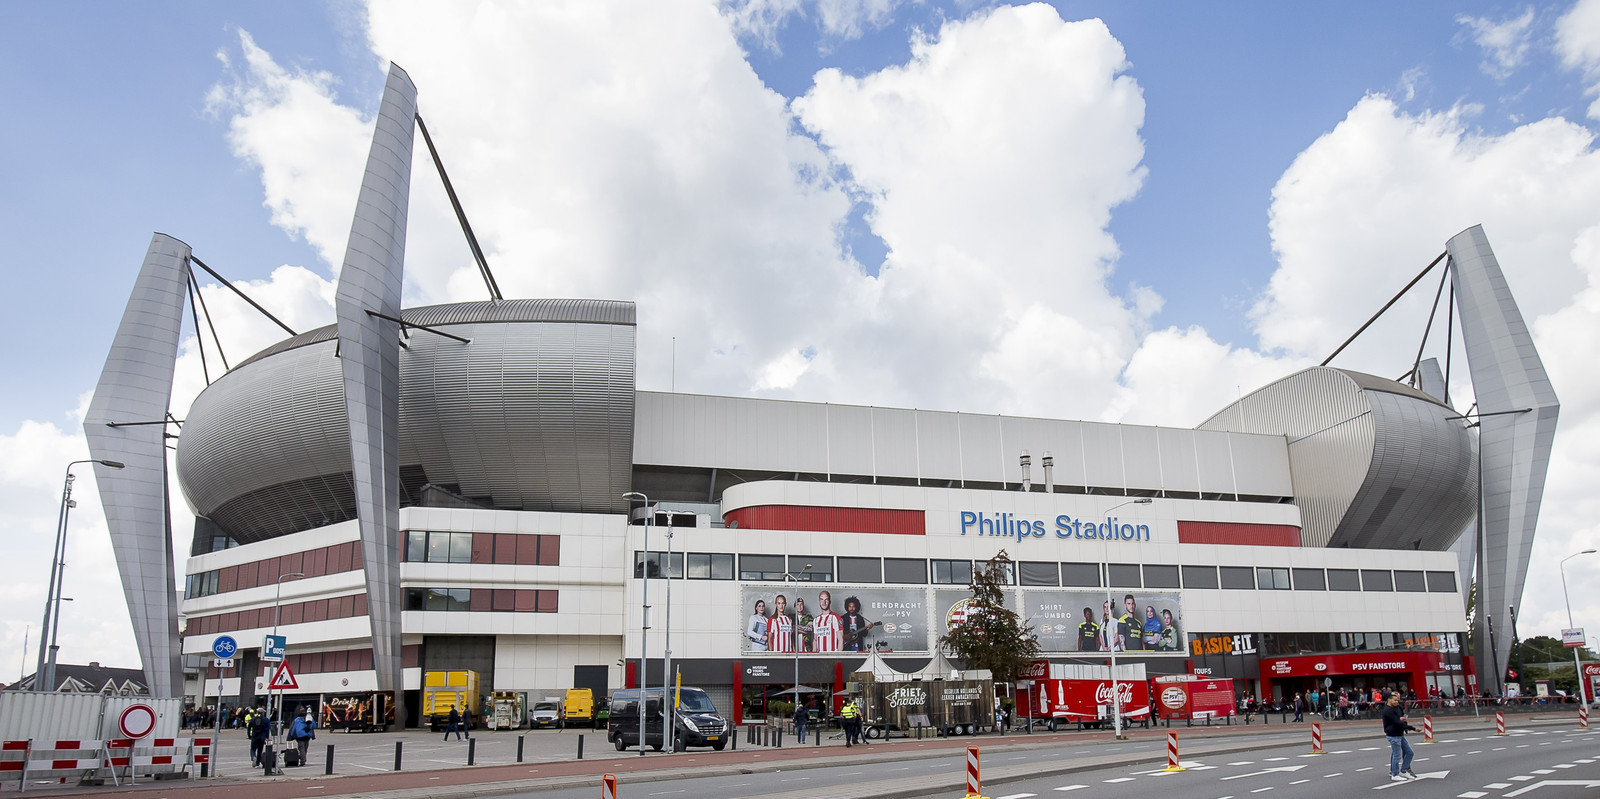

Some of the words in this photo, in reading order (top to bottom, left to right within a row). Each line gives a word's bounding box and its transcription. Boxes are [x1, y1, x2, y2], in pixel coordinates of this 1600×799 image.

[960, 511, 1046, 543] Philips
[1055, 514, 1151, 541] Stadion
[265, 637, 275, 654] P
[1368, 662, 1406, 670] FANSTORE
[331, 697, 358, 705] Drinks
[890, 692, 927, 708] Snacks
[894, 688, 922, 699] FRIET
[1095, 682, 1134, 704] CocaCola
